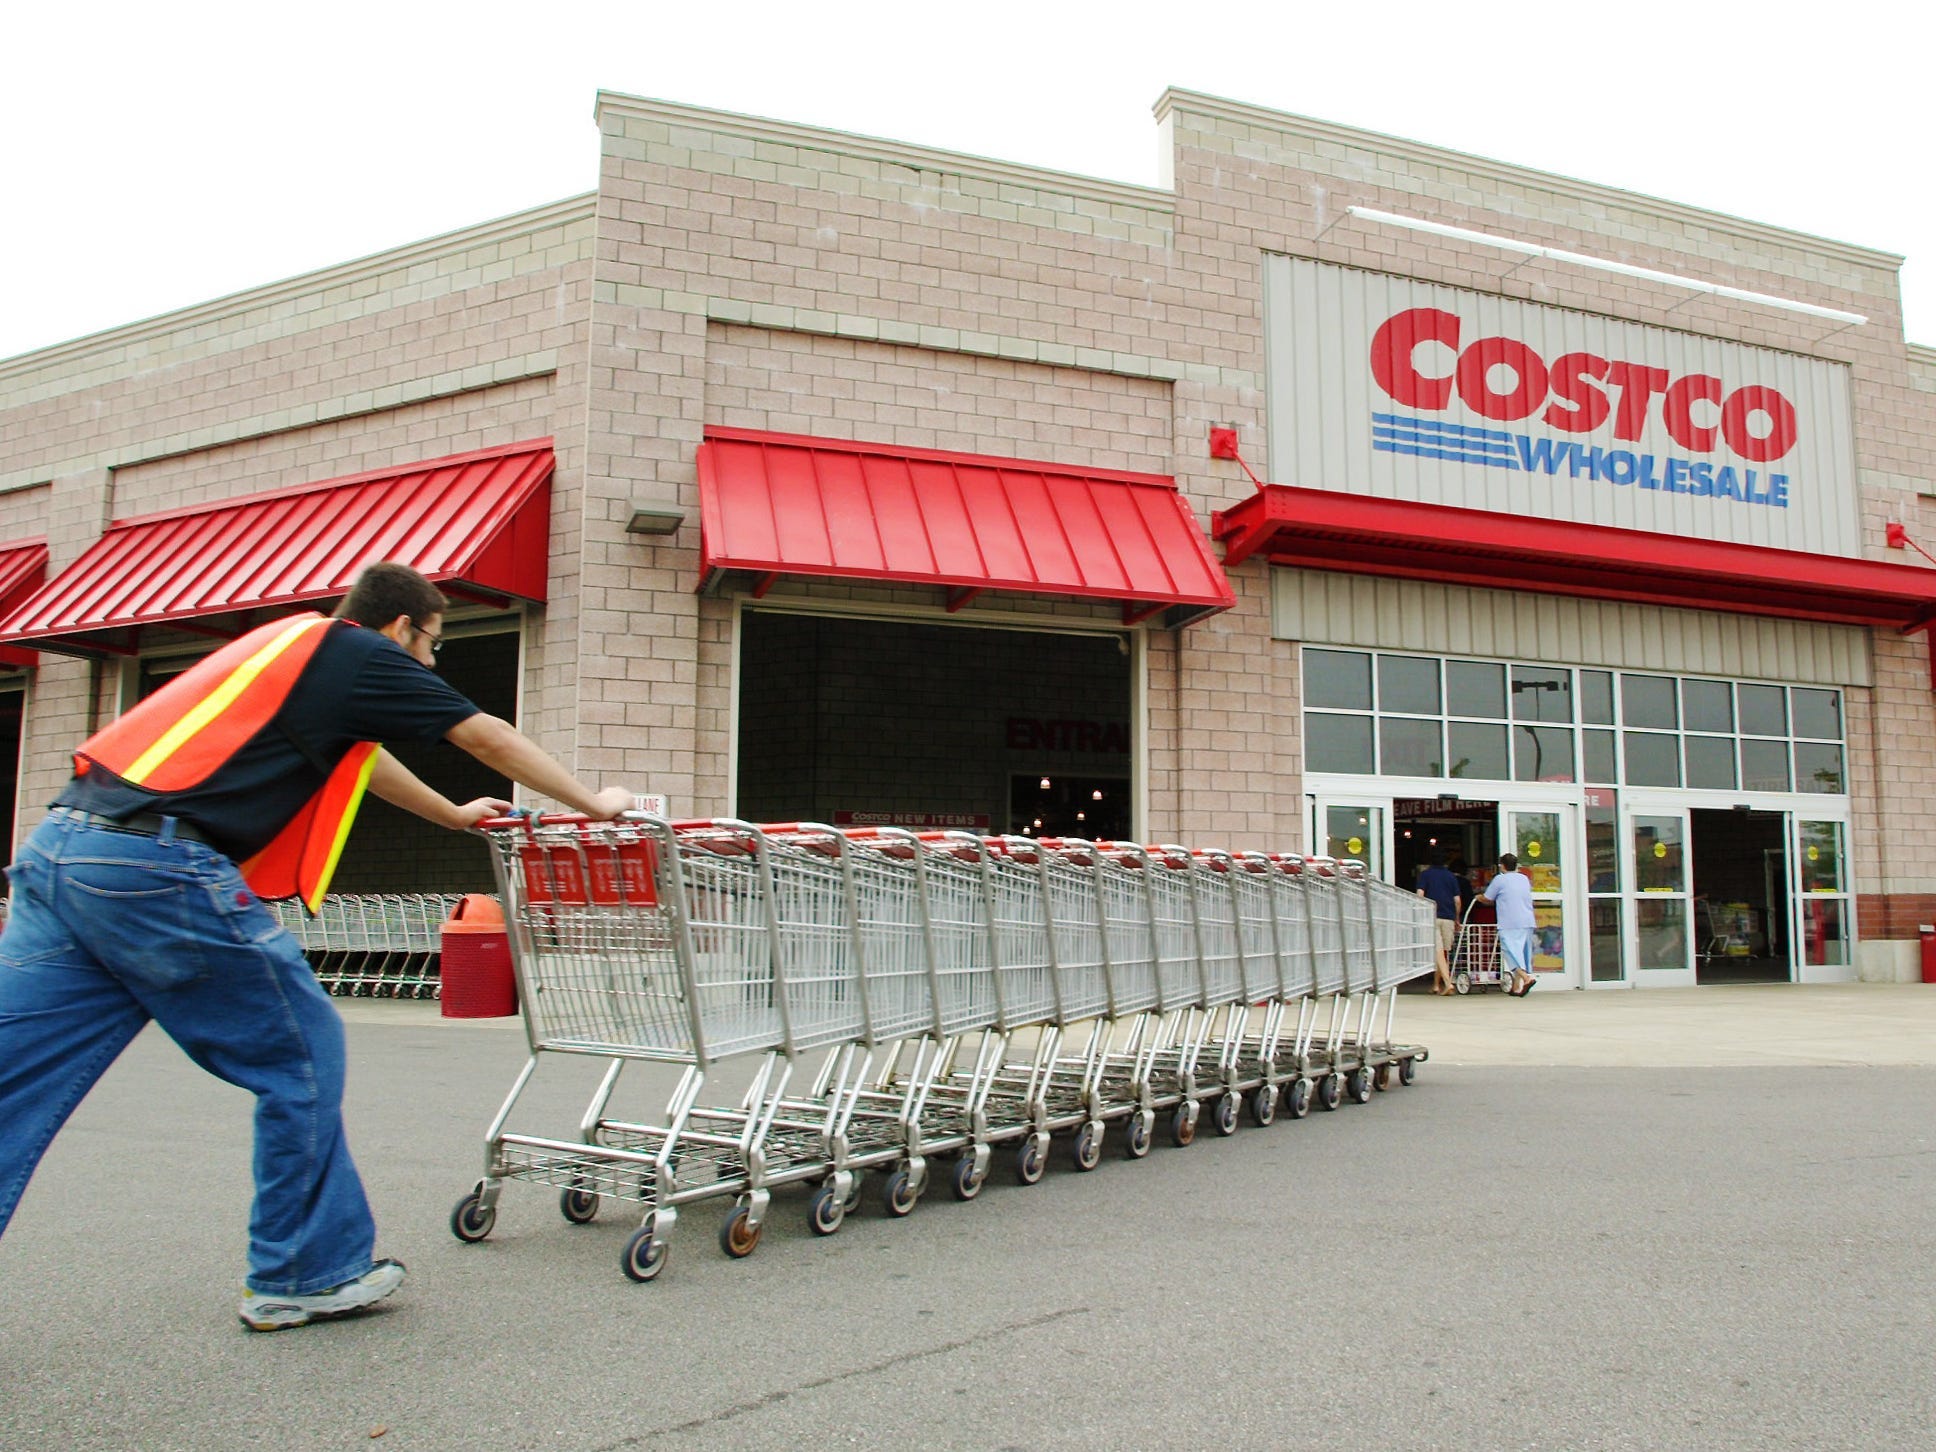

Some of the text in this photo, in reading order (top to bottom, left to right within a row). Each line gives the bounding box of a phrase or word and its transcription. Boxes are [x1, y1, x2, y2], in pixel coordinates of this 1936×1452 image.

[1370, 307, 1797, 462] COSTCO
[1515, 434, 1789, 508] WHOLESALE
[851, 812, 976, 825] COSTCO NEW ITEMS
[1394, 801, 1421, 816] EAVE
[1424, 799, 1452, 814] FILM
